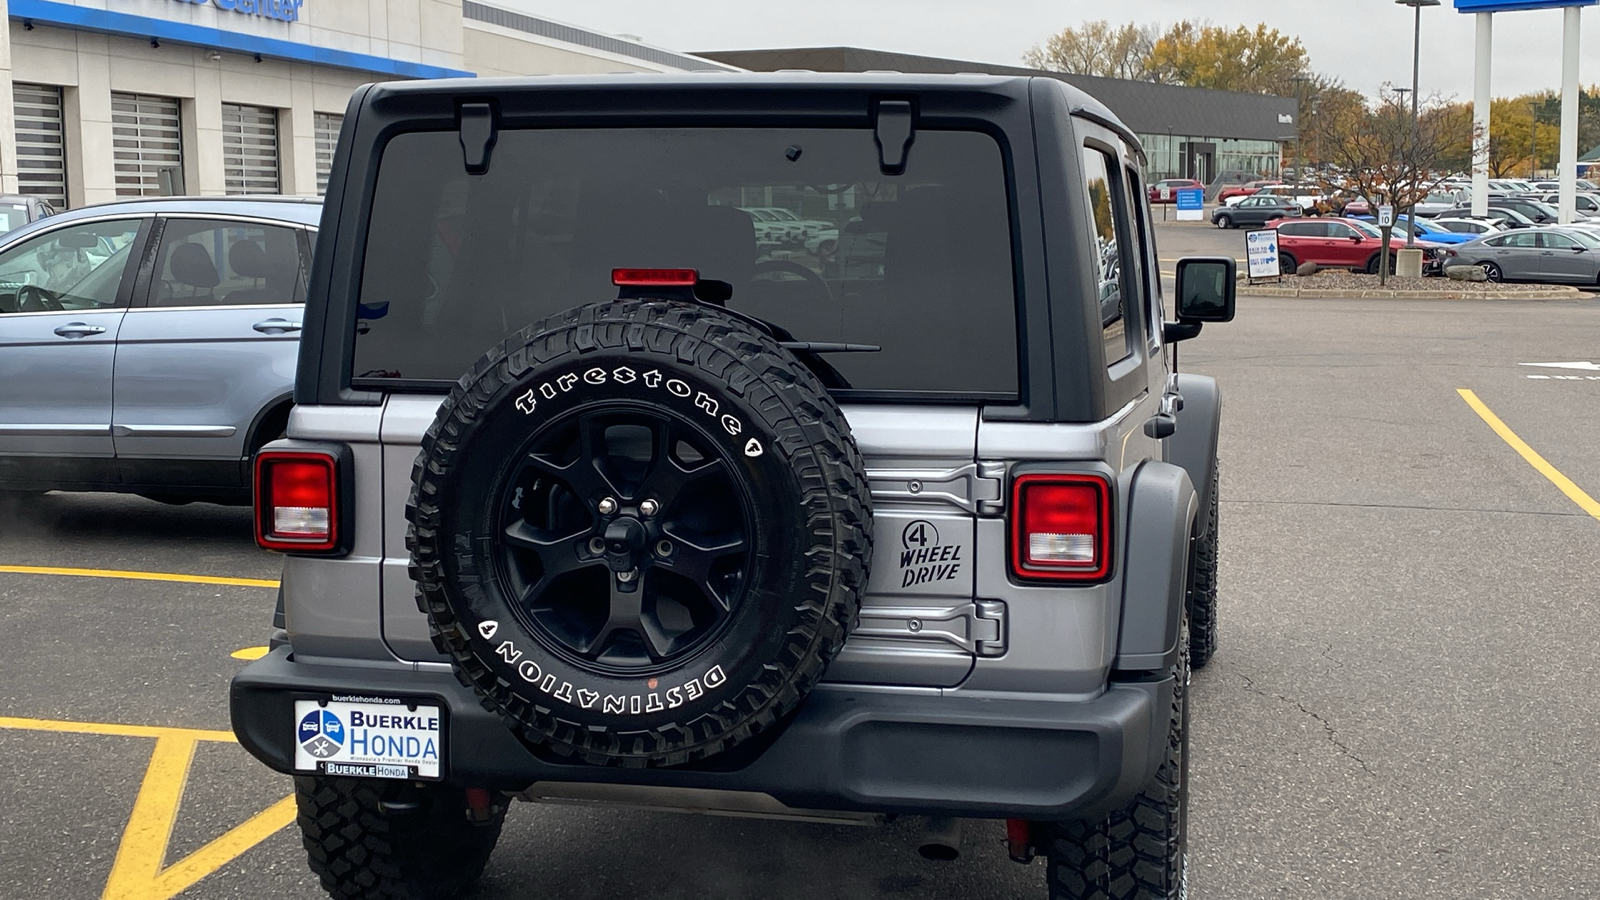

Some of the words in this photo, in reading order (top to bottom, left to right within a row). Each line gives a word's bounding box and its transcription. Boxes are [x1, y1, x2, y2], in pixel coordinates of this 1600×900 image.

[1381, 216, 1390, 224] 10
[515, 366, 742, 435] Firestone
[908, 524, 927, 546] 4
[900, 545, 961, 568] WHEEL
[902, 564, 960, 588] DRIVE
[495, 640, 727, 714] DESTINATION
[332, 694, 401, 705] buerklehonda.com
[350, 710, 438, 731] BUERKLE
[350, 729, 438, 760] HONDA
[327, 763, 376, 776] BUERKLE
[377, 766, 406, 777] HONDA
